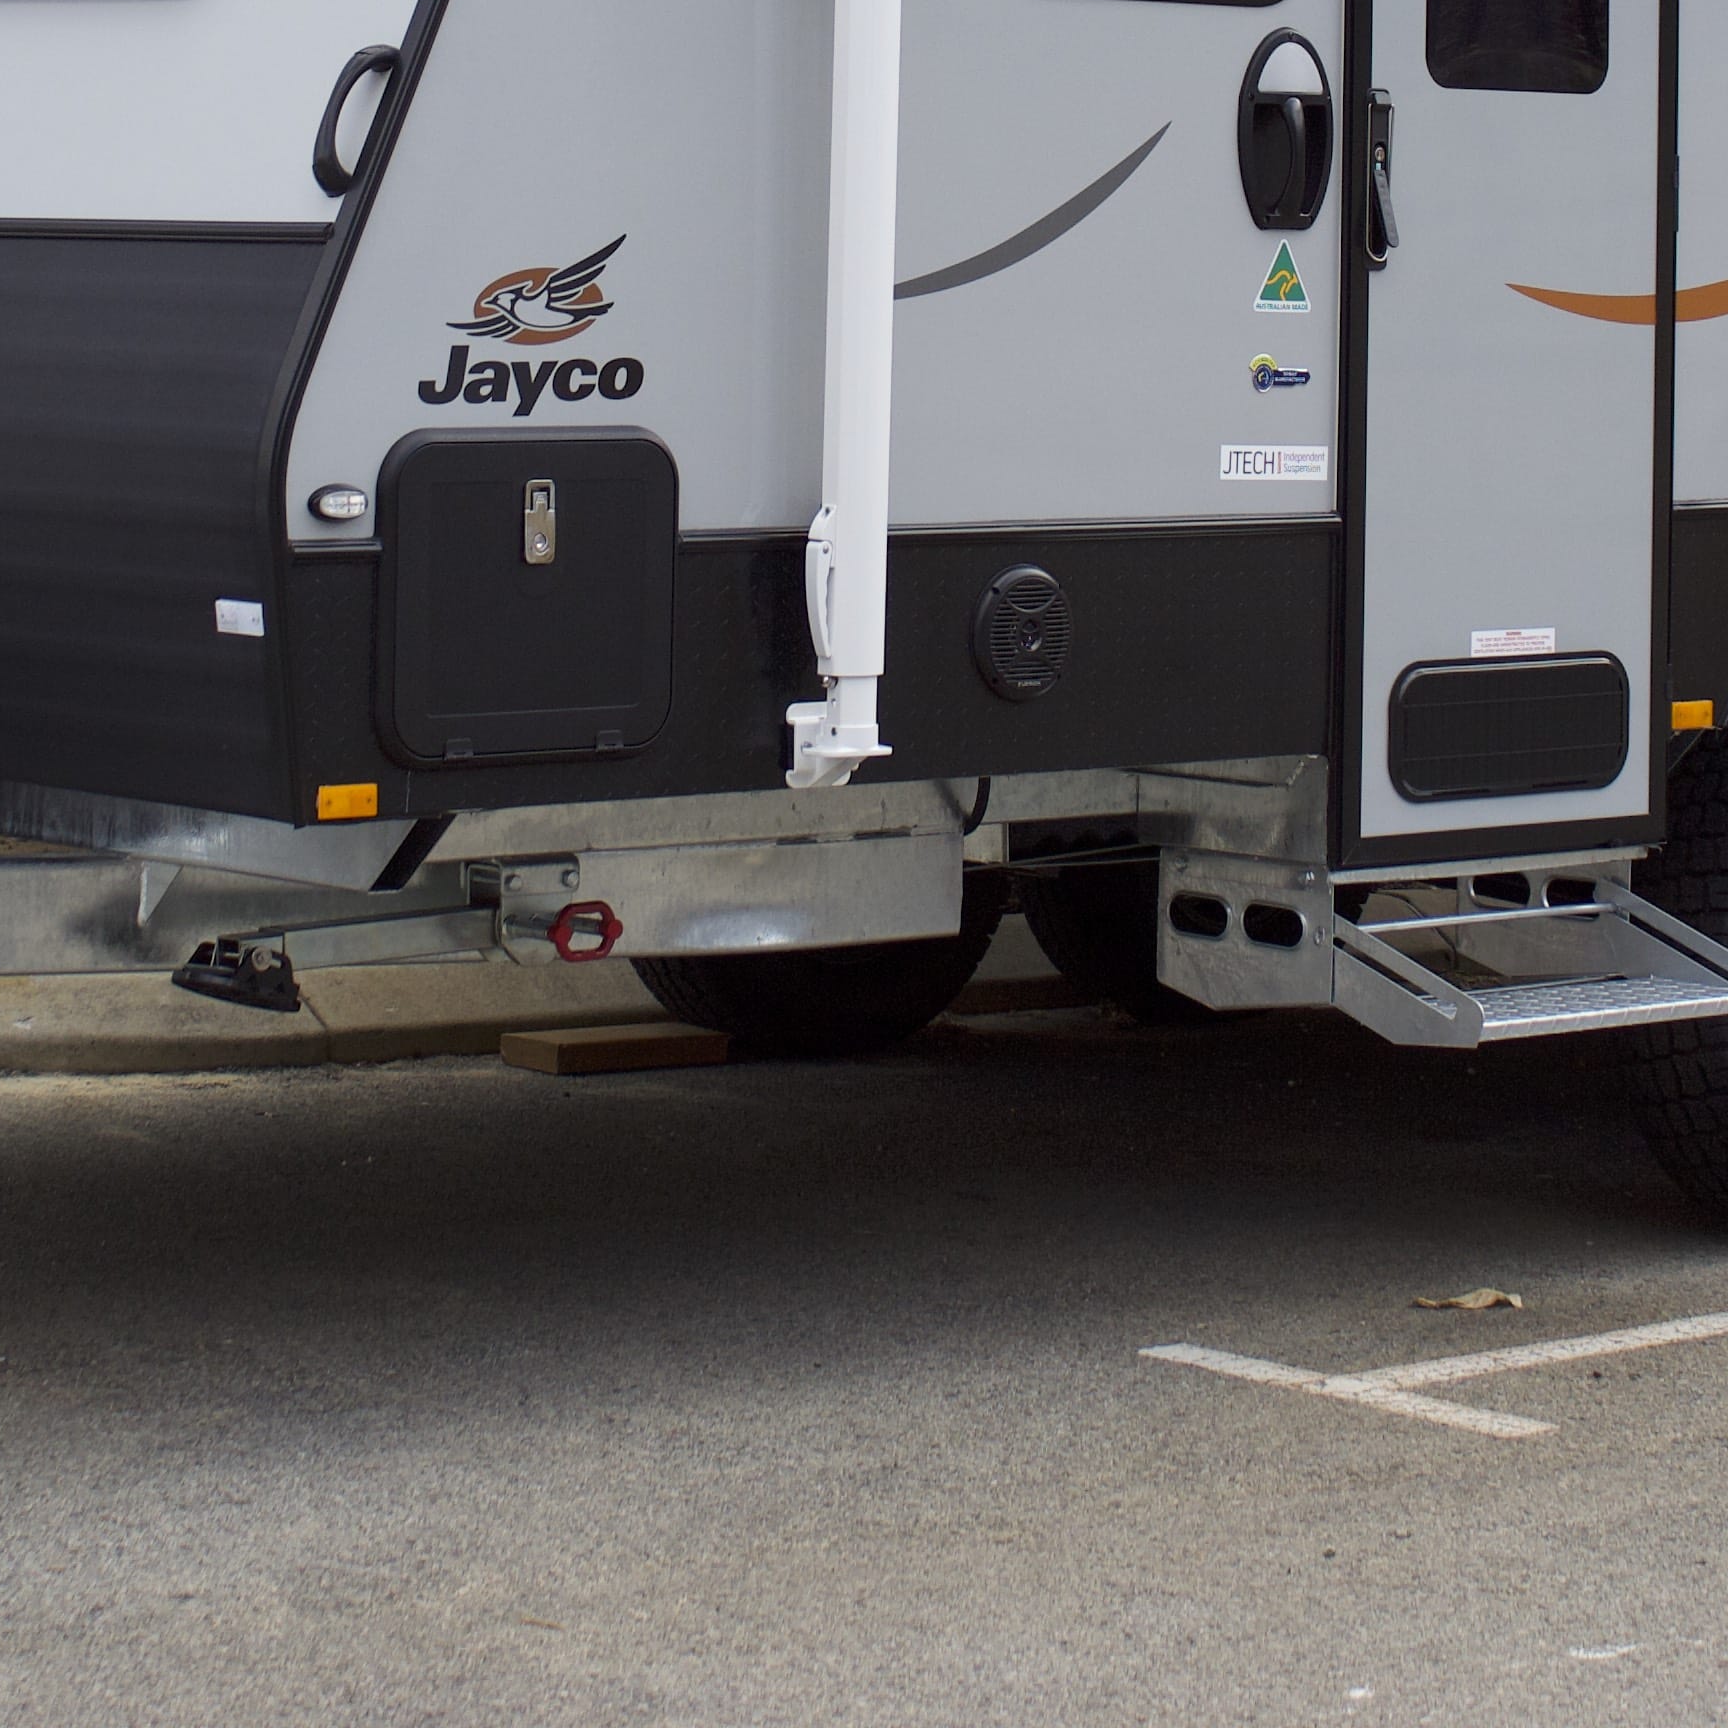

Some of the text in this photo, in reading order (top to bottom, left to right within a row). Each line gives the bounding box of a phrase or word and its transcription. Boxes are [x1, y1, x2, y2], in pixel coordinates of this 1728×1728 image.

[1255, 302, 1291, 310] AUSTRALIAN
[417, 344, 644, 416] Jayco
[1222, 450, 1275, 475] JTECH
[1283, 450, 1326, 464] Independent
[1283, 463, 1322, 475] Suspension
